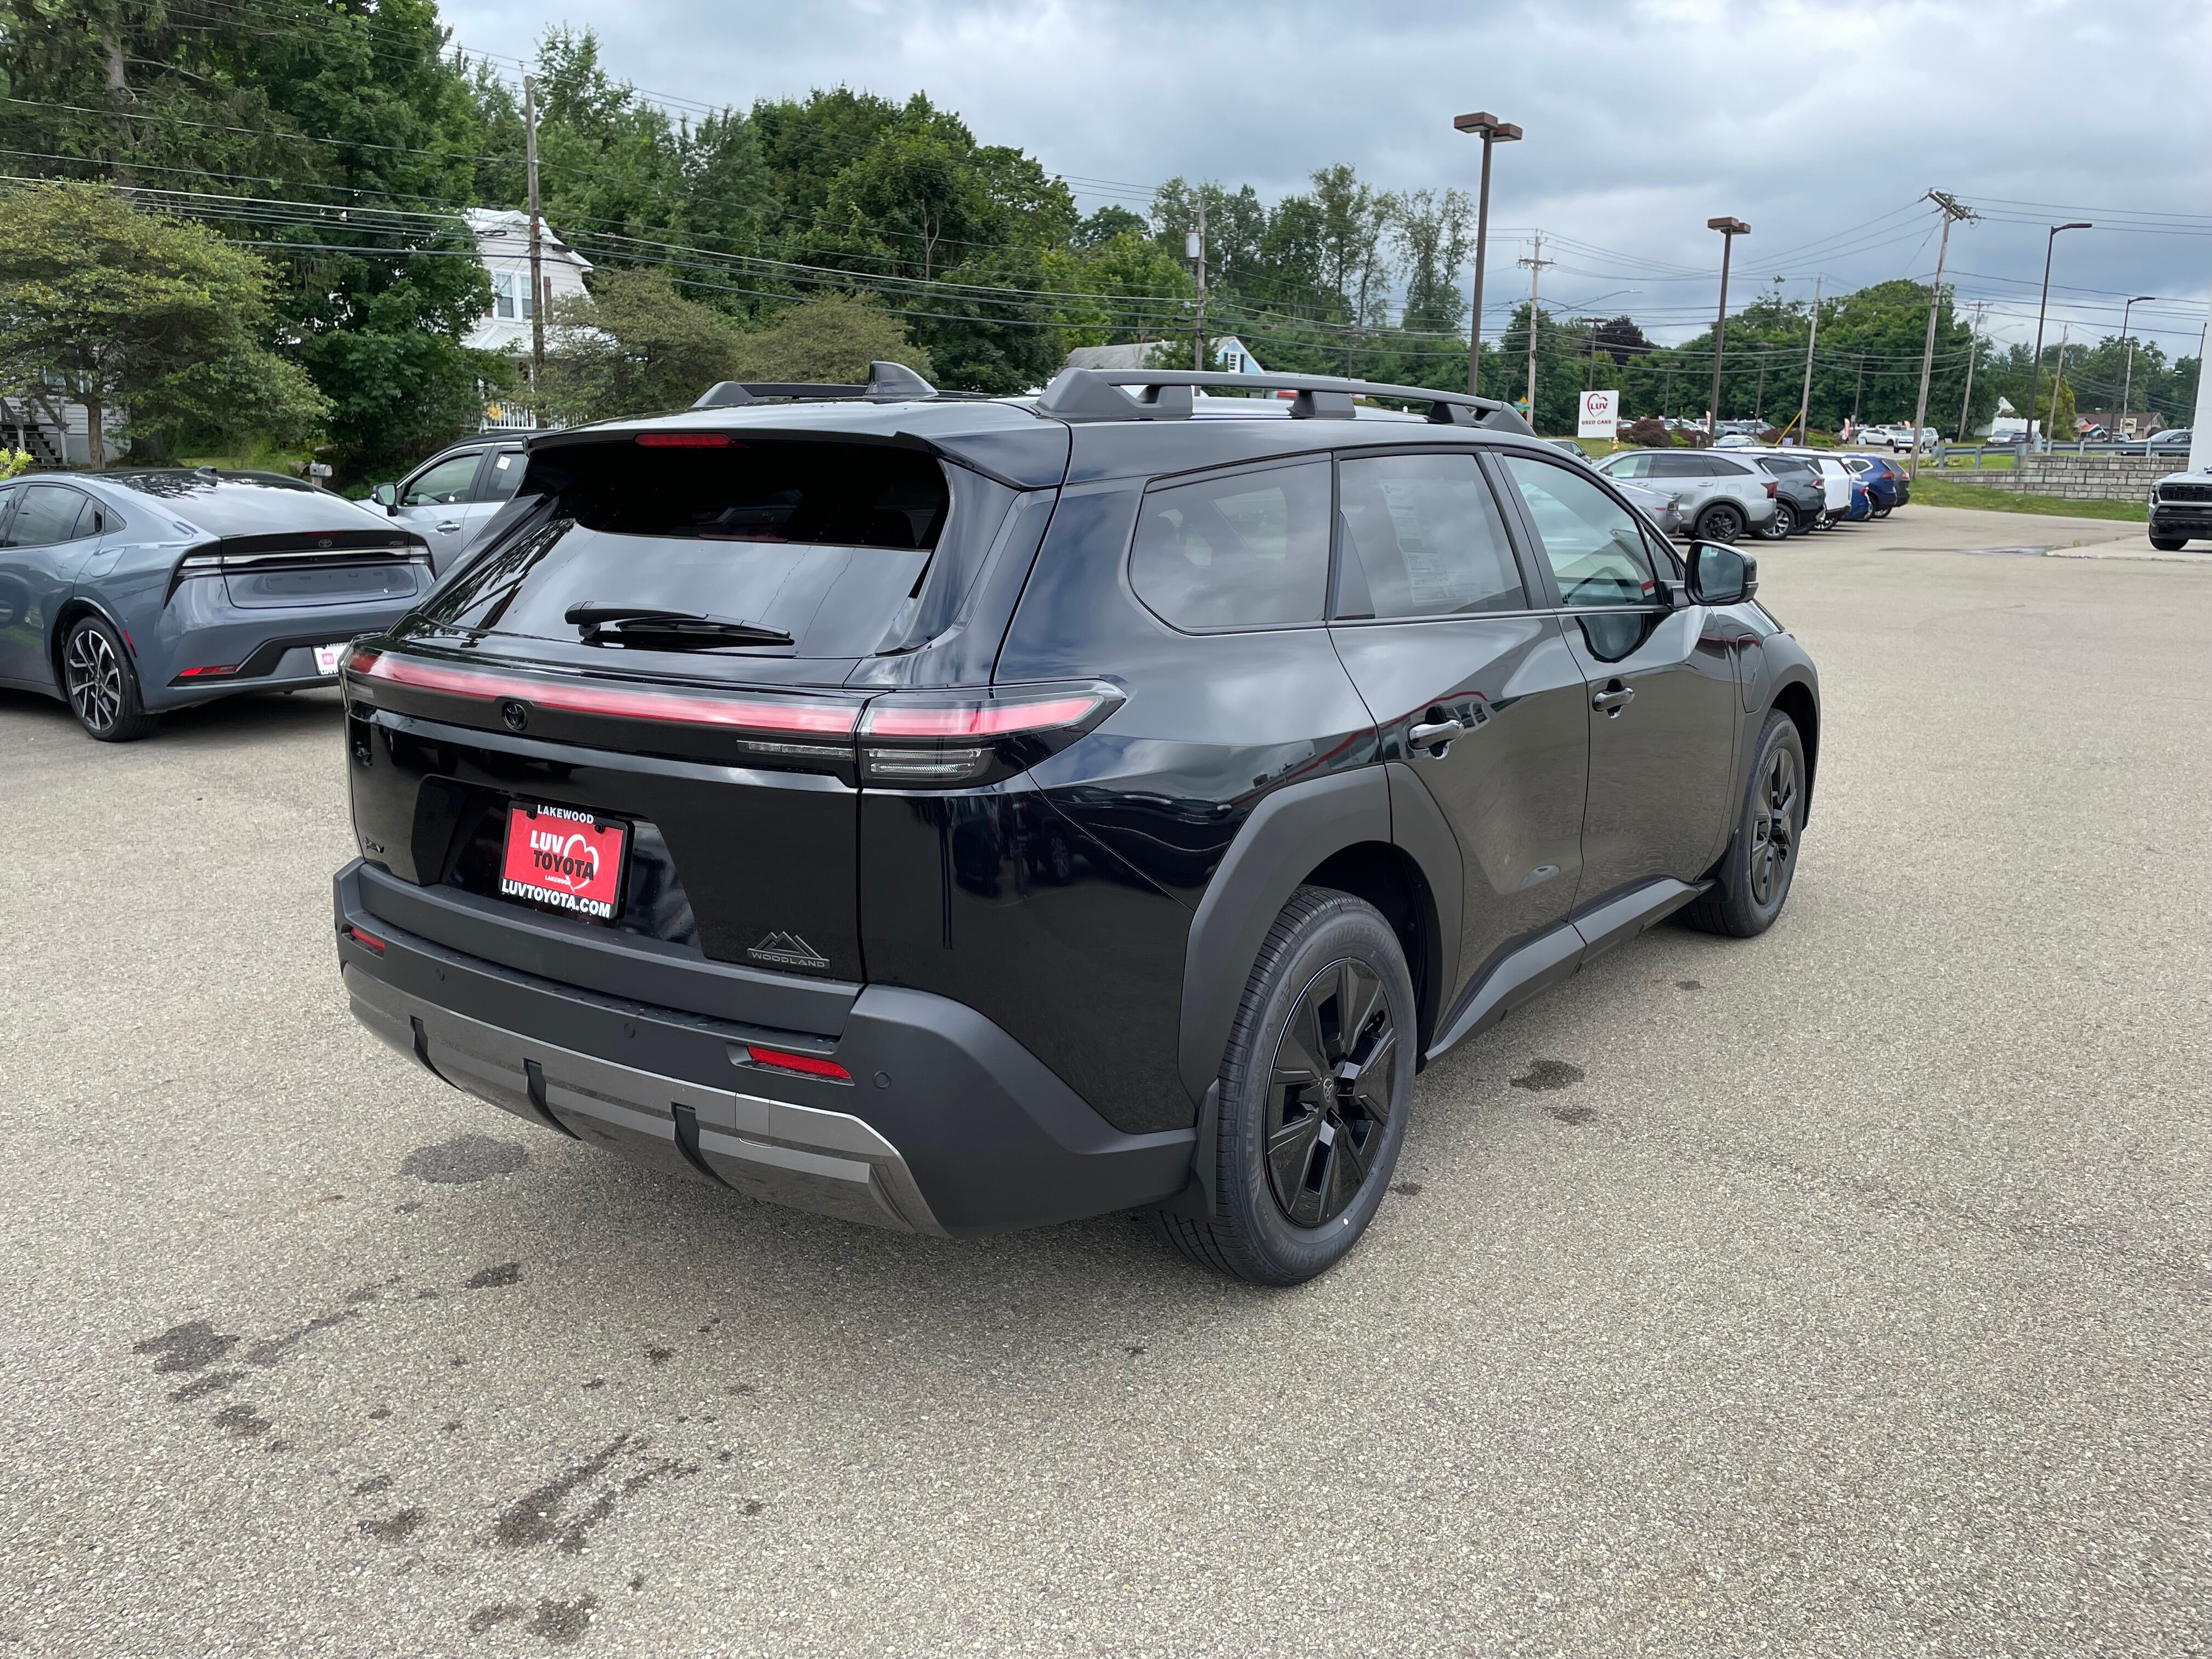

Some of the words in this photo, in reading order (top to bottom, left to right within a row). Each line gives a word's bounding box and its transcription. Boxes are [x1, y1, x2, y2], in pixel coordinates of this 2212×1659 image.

[537, 804, 594, 824] LAKEWOOD
[530, 830, 564, 853] LUV
[533, 850, 594, 881] TOYOTA
[545, 874, 571, 886] LAKEWOOD
[501, 879, 611, 918] LUVTOYOTA.COM
[751, 952, 826, 968] WOODLAND
